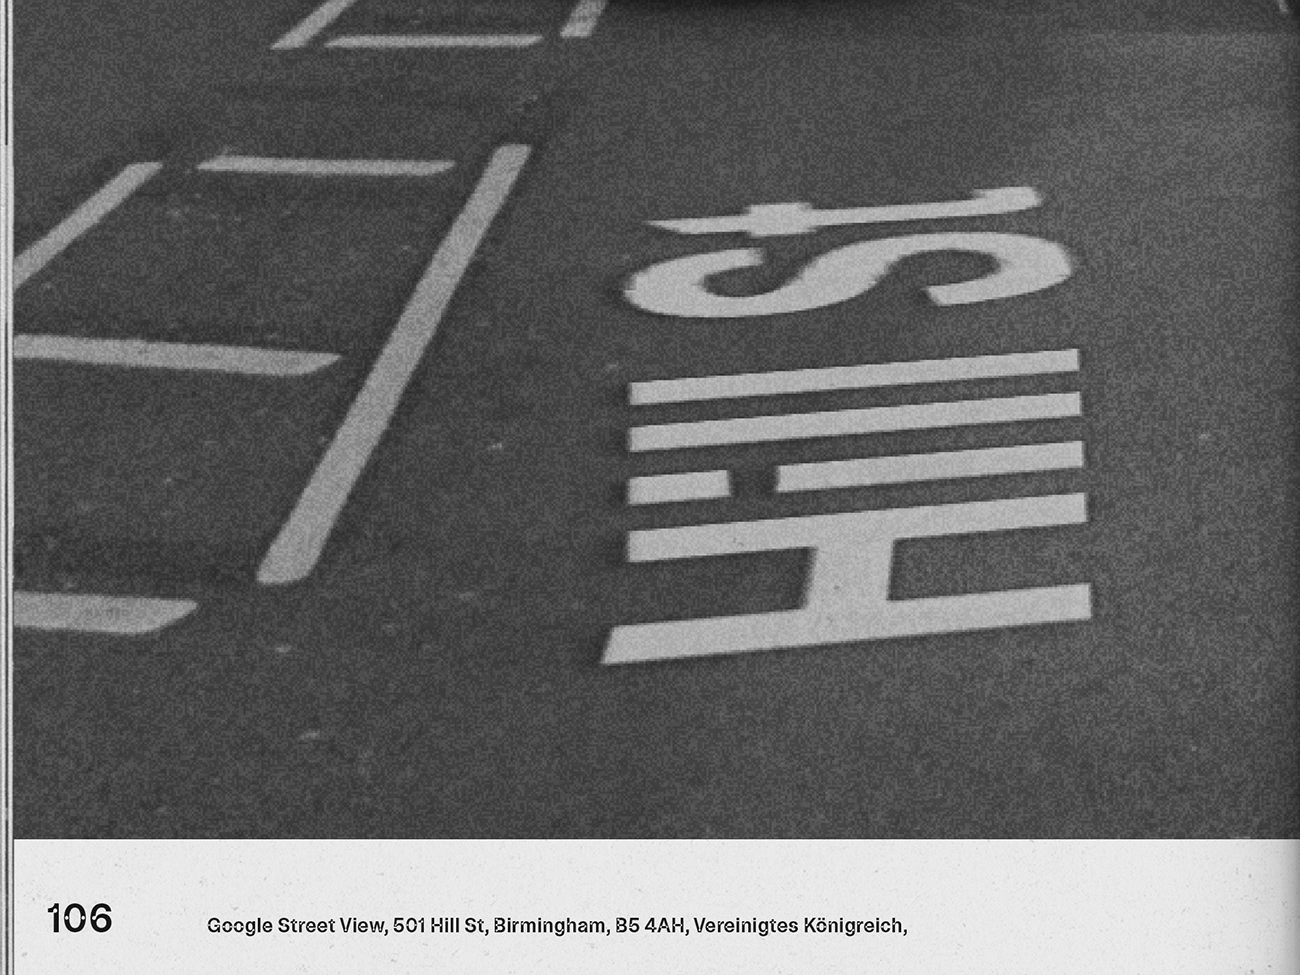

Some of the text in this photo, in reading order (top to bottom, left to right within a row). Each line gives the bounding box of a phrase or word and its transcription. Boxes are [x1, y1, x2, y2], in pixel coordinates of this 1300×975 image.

[600, 186, 1092, 666] Hill St
[48, 903, 112, 933] 106
[208, 917, 908, 936] Google Street View, 501 Hill St, Birmingham, B5 4AH, Vereinigtes Königreich,
